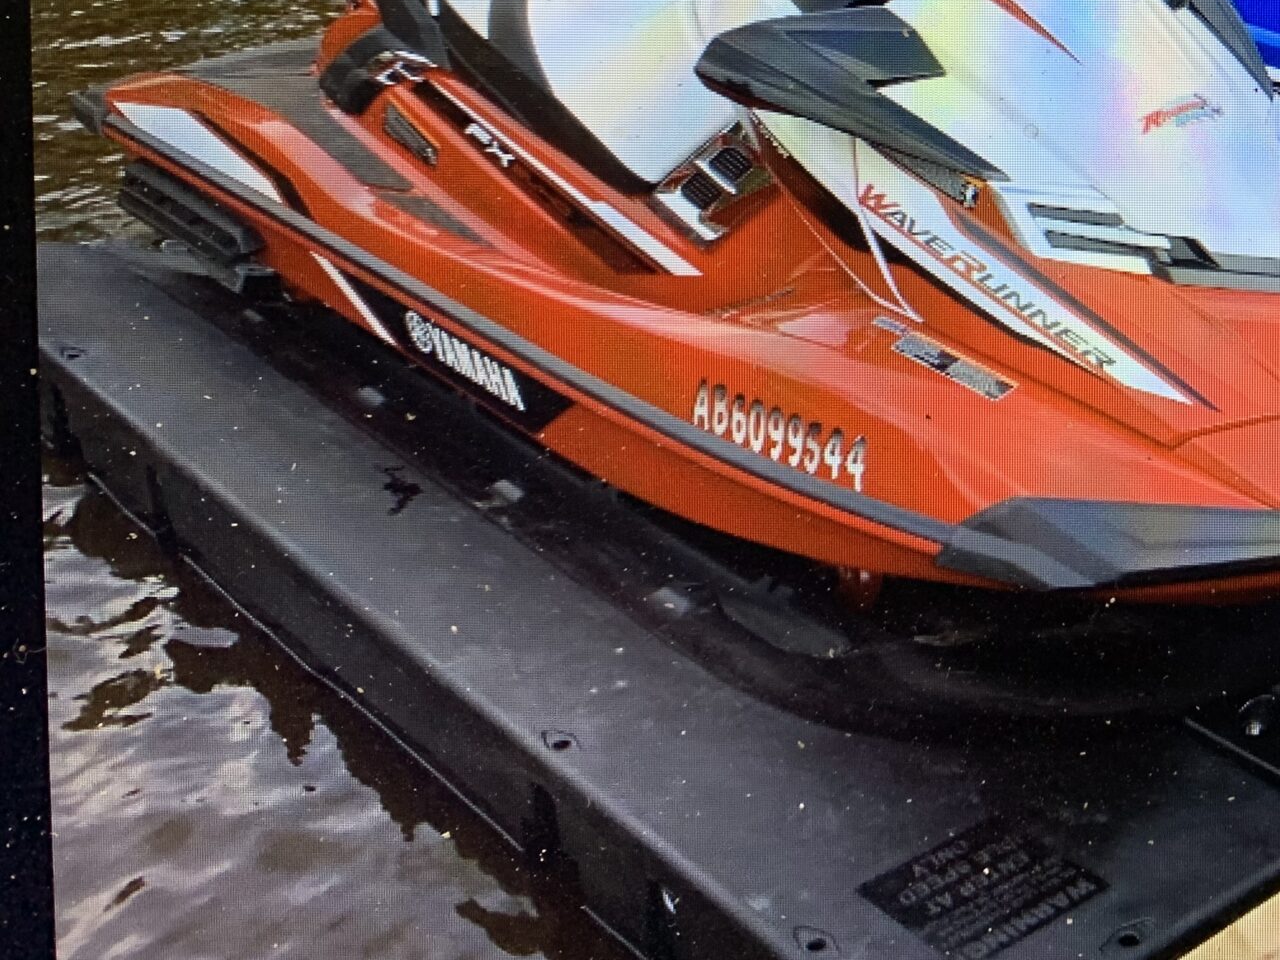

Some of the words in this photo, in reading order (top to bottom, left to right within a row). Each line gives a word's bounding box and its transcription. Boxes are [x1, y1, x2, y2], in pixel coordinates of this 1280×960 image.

[465, 123, 516, 167] FX
[858, 184, 1117, 371] WAVERUNNER
[426, 323, 526, 411] YAMAHA
[693, 377, 867, 492] AB6099544
